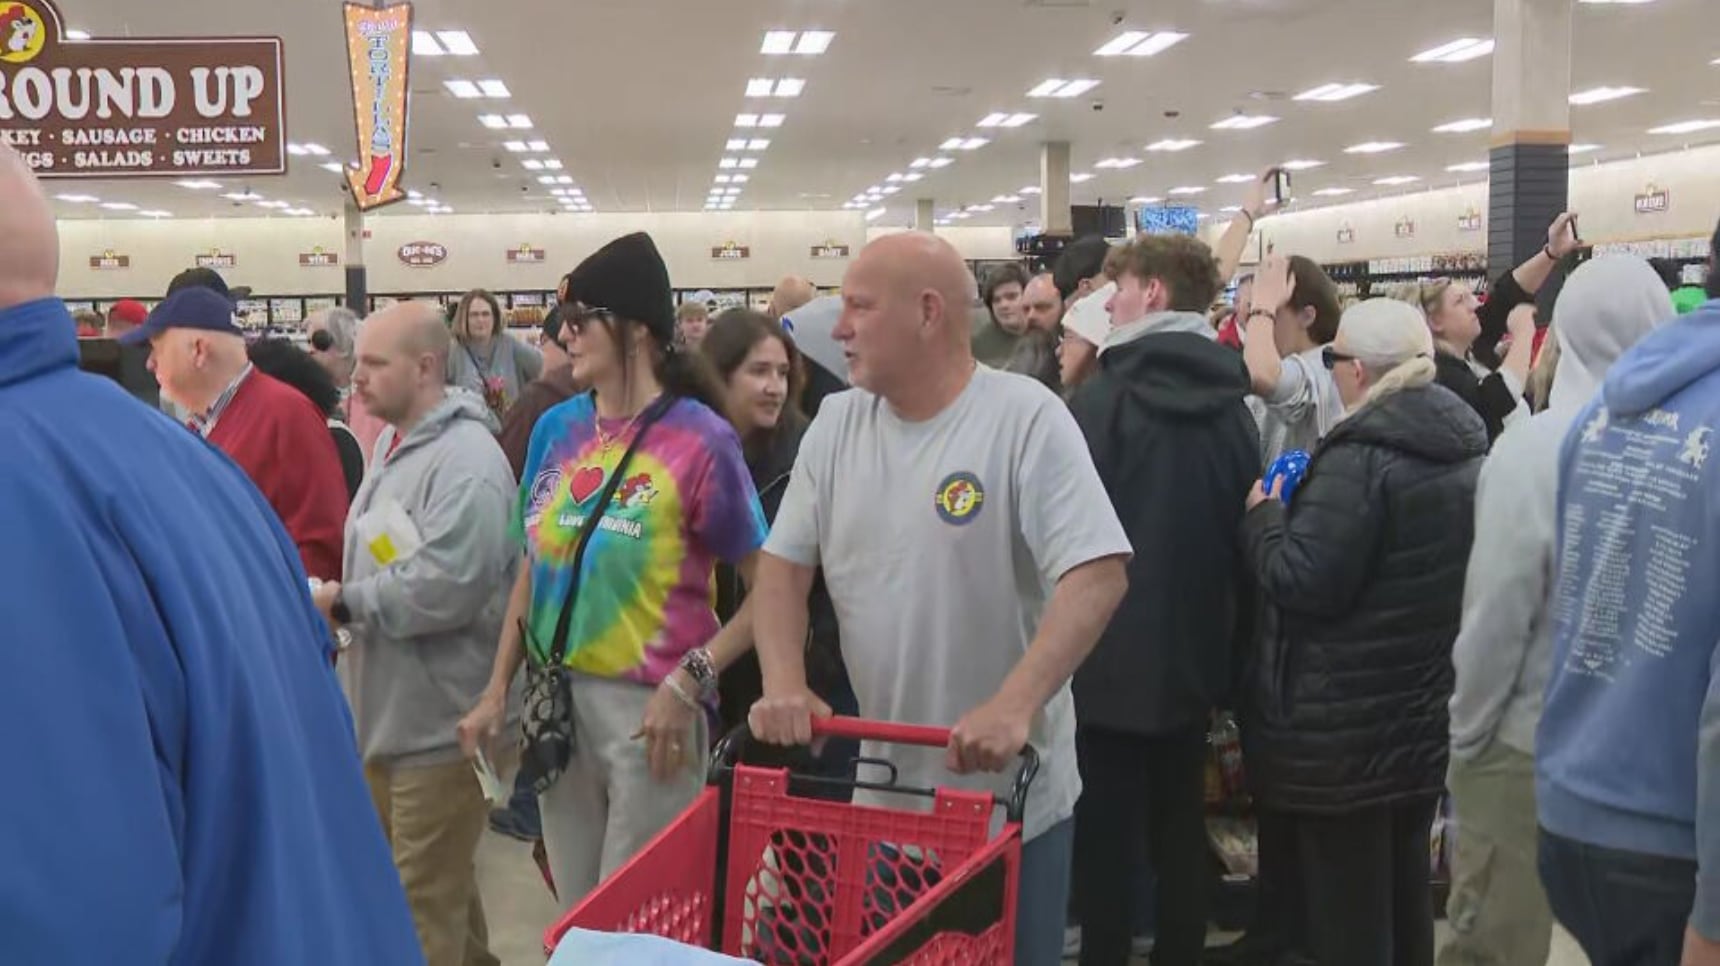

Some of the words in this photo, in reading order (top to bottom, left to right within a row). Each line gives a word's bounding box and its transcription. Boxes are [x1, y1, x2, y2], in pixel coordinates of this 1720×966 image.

[190, 66, 265, 118] UP
[62, 128, 157, 145] SAUSAGE
[176, 126, 265, 143] CHICKEN
[74, 150, 153, 168] SALADS
[172, 148, 250, 166] SWEETS
